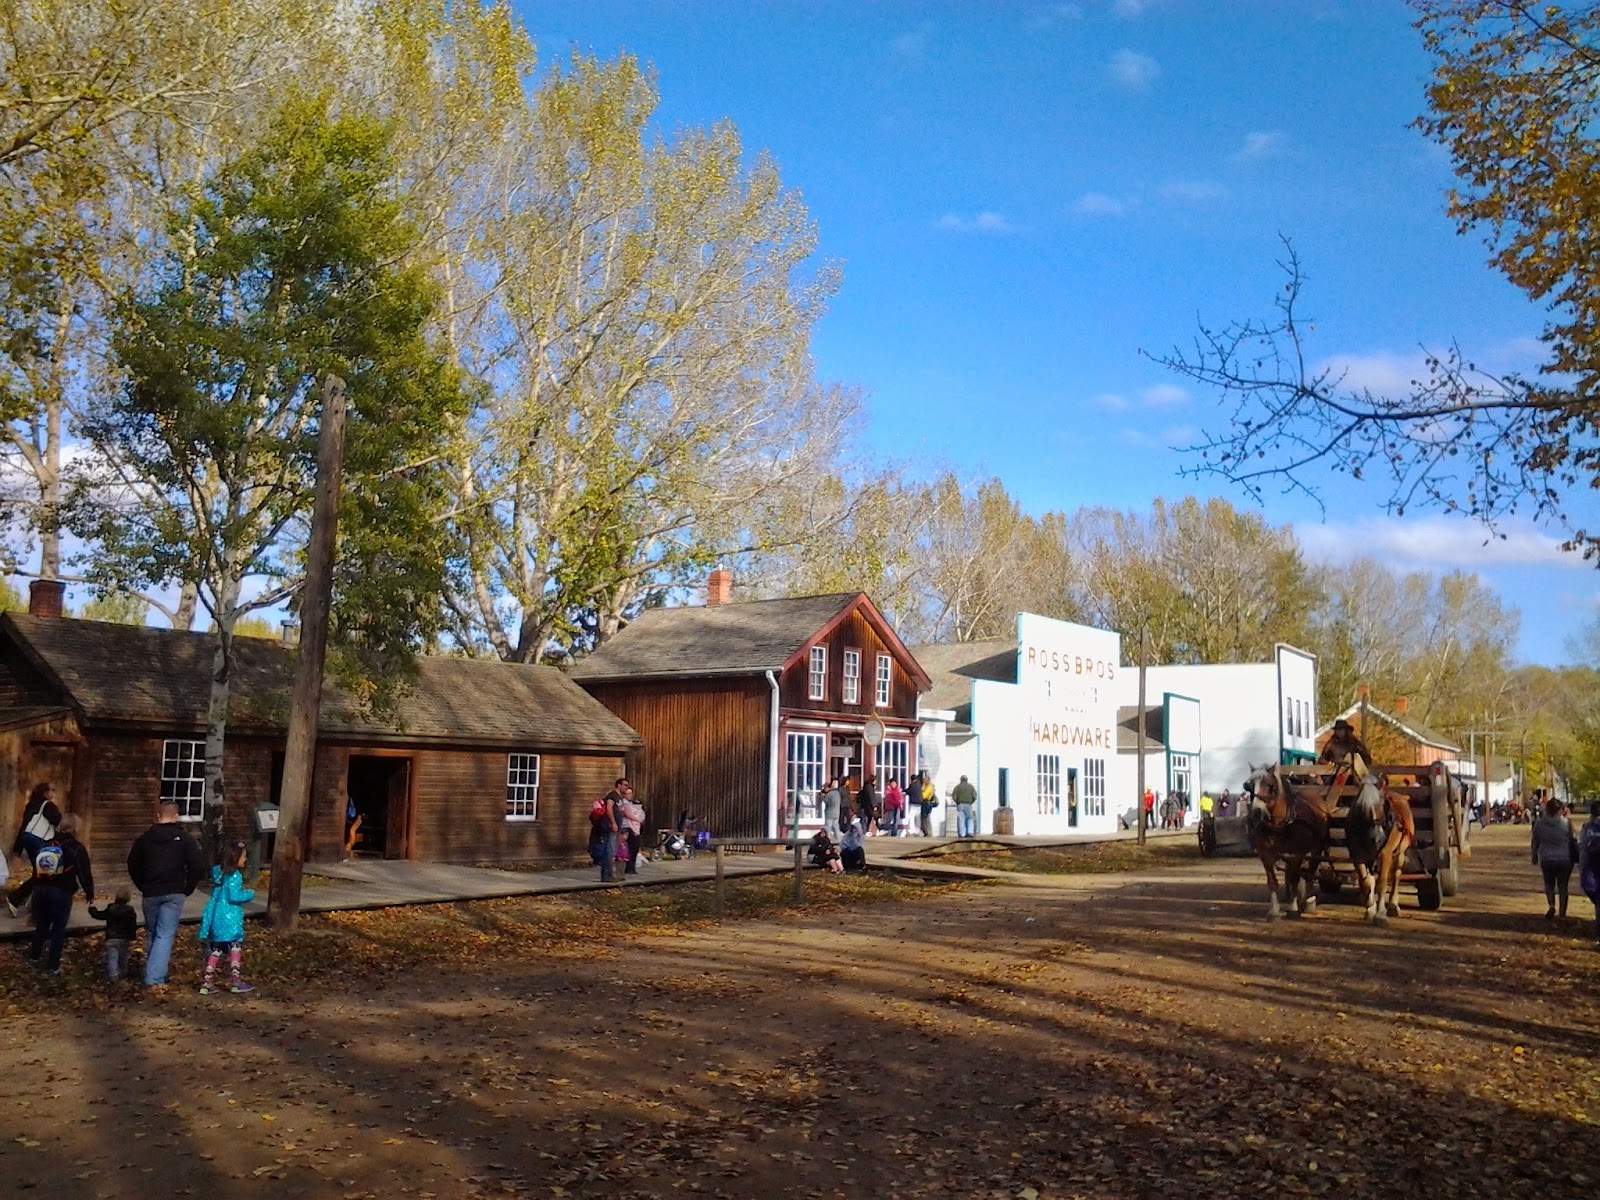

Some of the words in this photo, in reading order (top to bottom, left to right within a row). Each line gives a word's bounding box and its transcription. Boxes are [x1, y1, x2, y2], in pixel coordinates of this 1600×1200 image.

[1028, 646, 1070, 672] ROSS
[1075, 656, 1114, 680] BROS
[1033, 722, 1111, 749] HARDWARE
